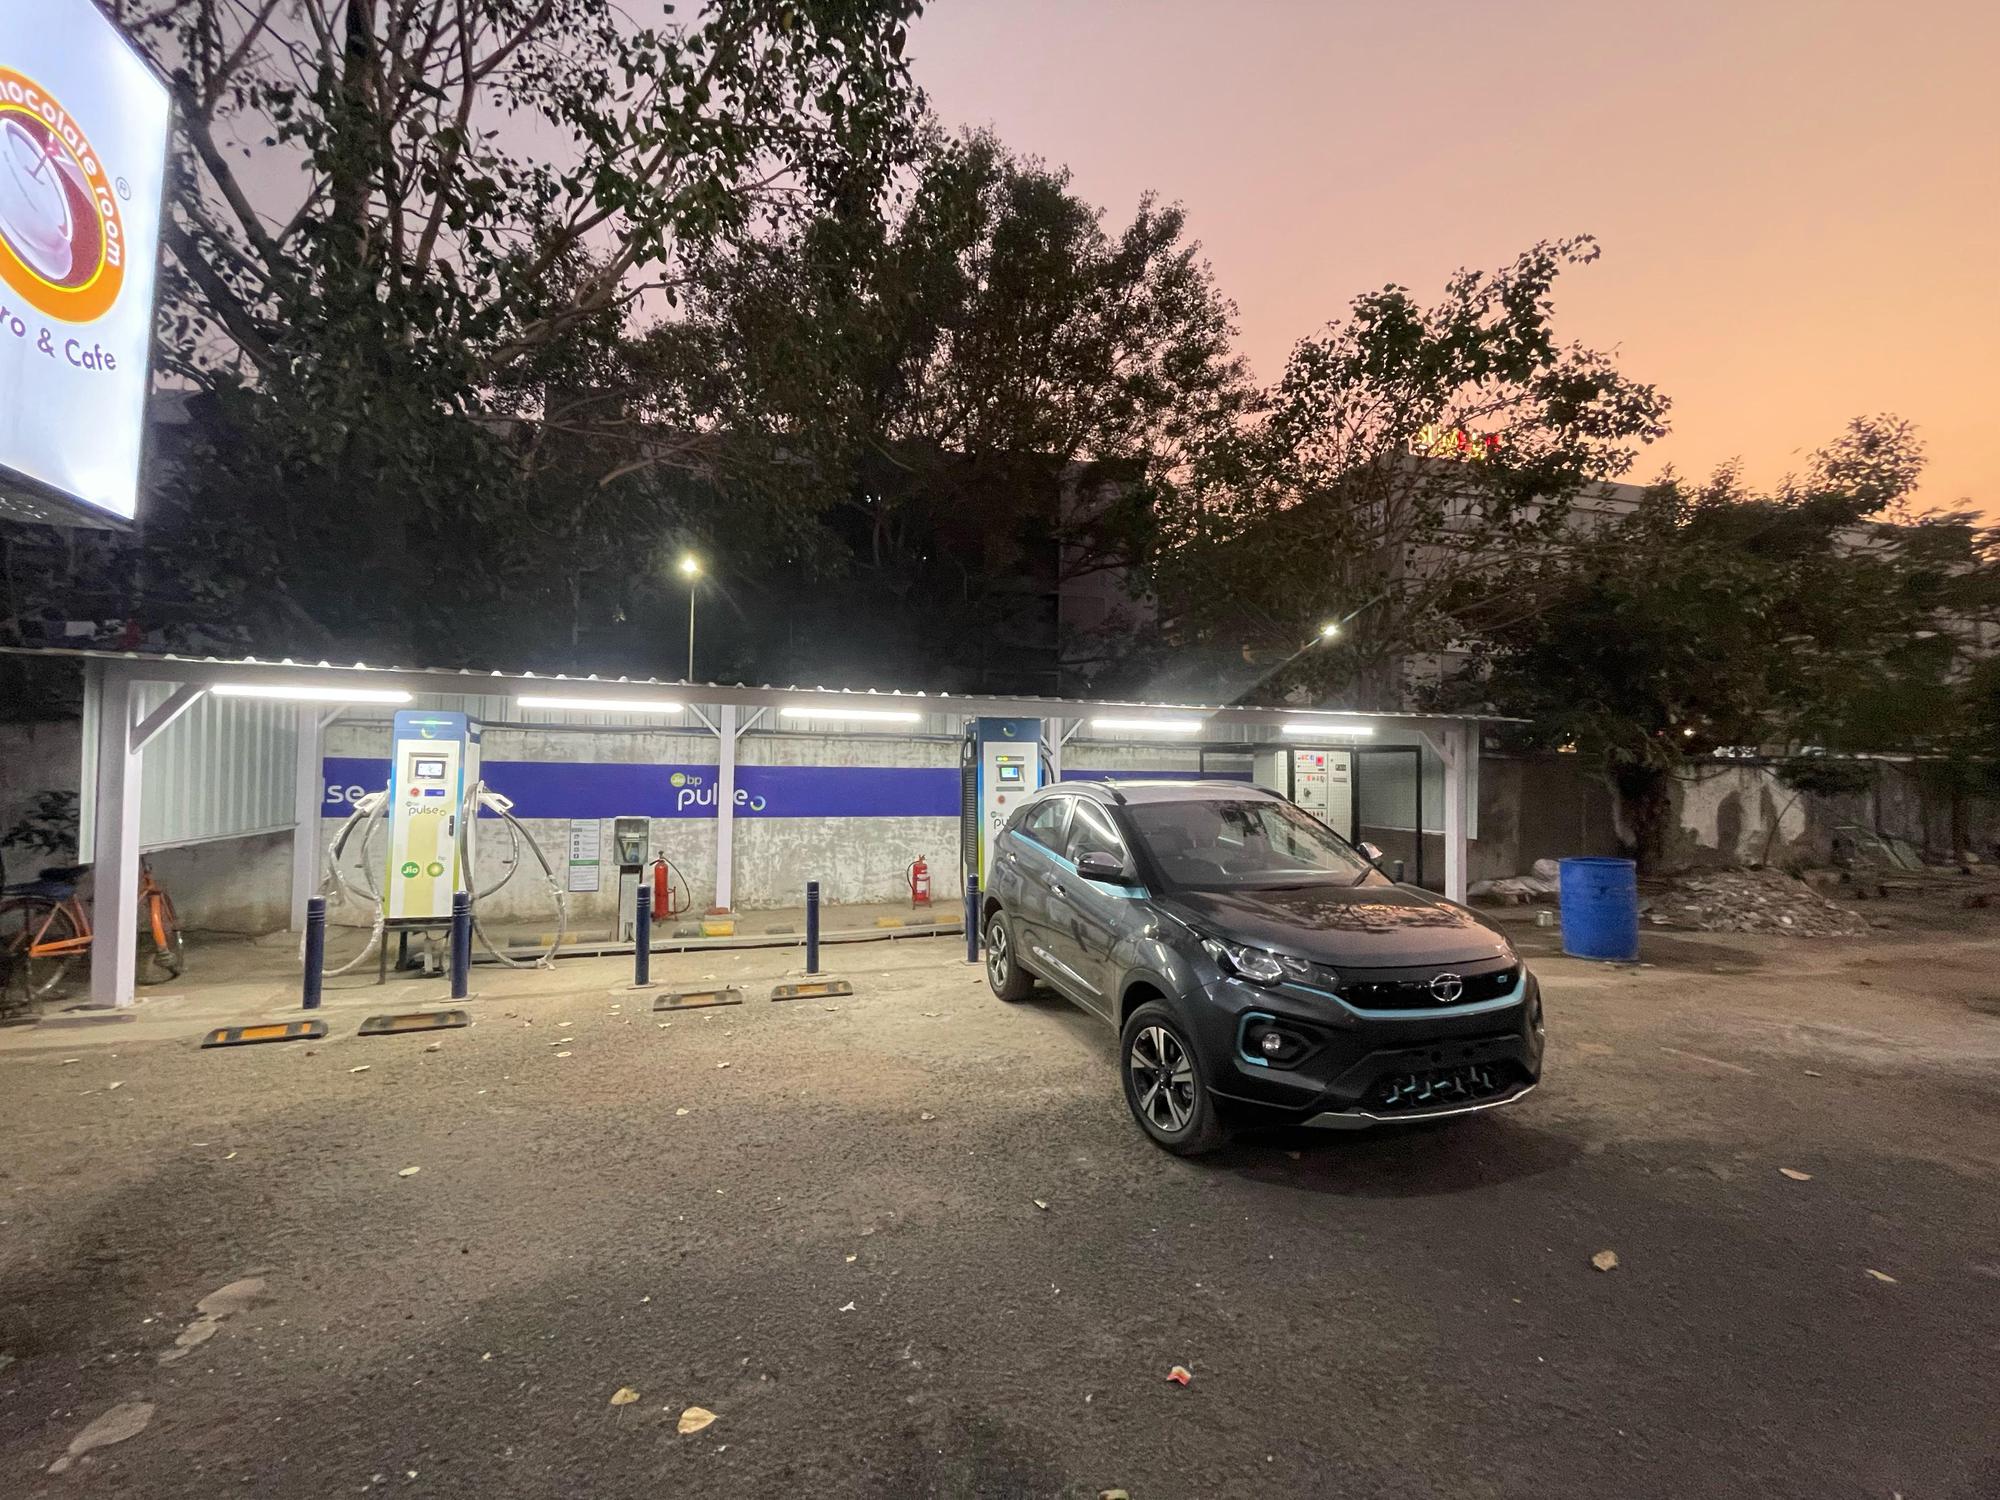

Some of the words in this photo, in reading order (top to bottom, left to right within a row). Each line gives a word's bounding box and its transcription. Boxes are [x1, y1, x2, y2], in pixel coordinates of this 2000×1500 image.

[95, 187, 120, 266] room
[37, 327, 56, 358] &
[65, 338, 117, 371] Cafe
[686, 775, 702, 787] bp
[408, 805, 439, 816] pulse
[677, 782, 748, 811] pule
